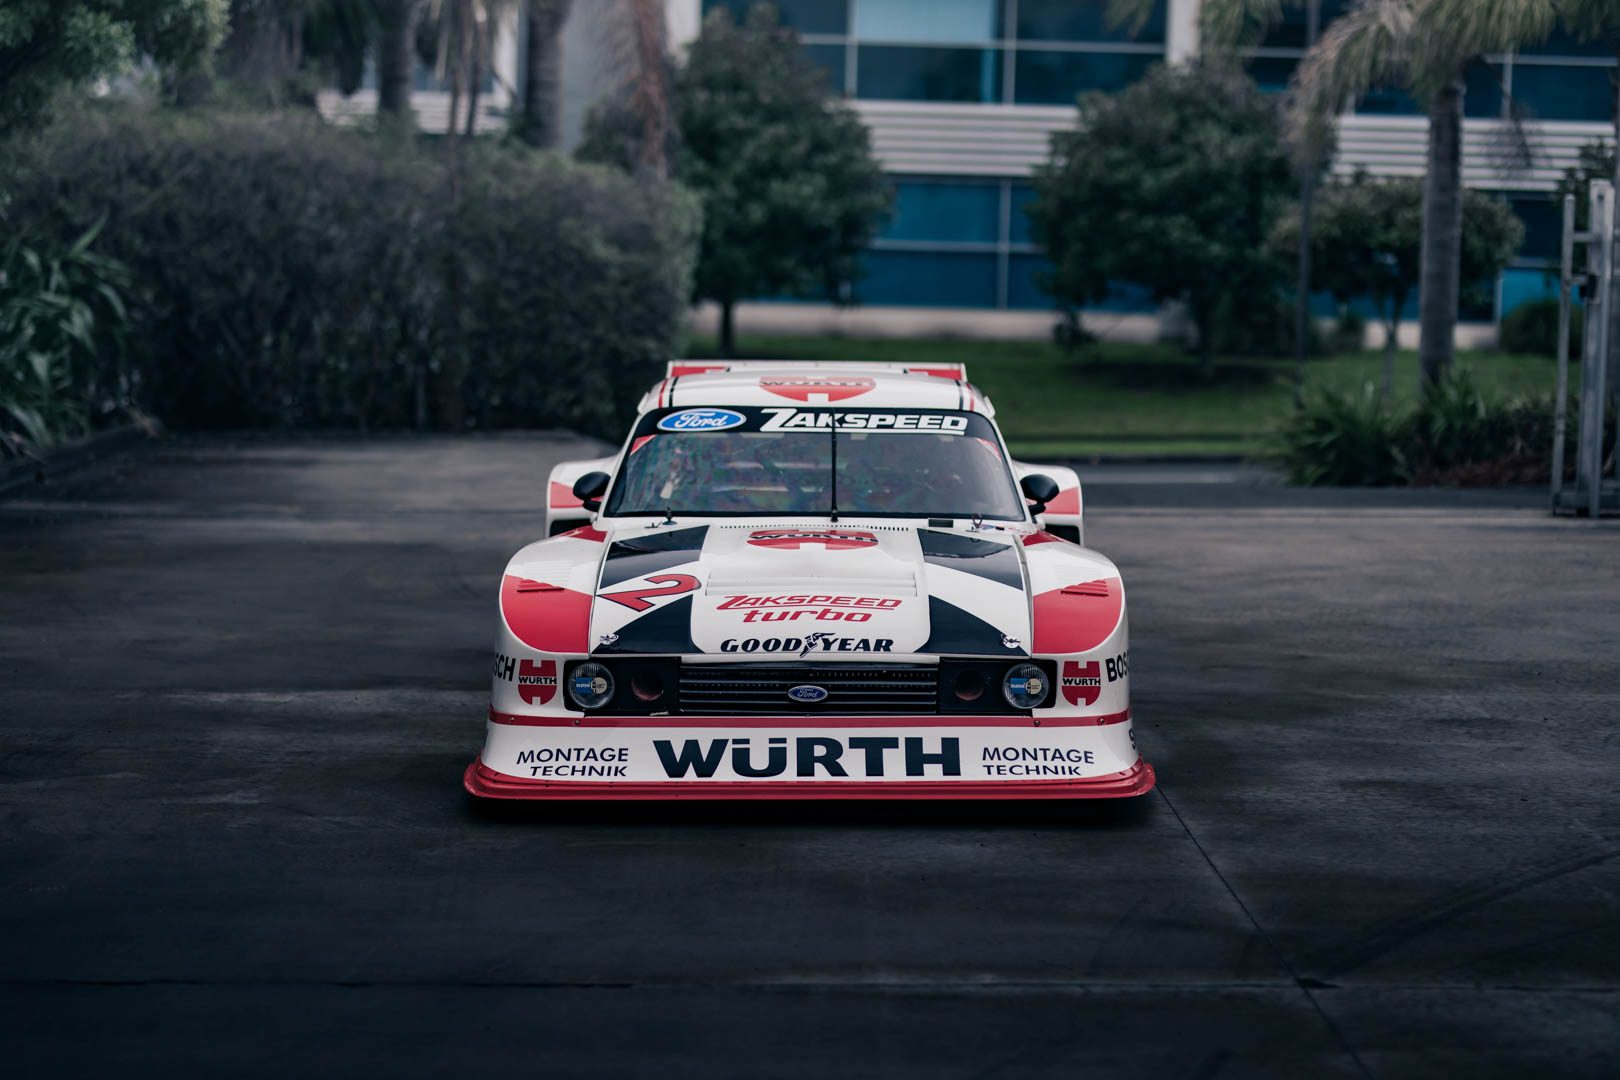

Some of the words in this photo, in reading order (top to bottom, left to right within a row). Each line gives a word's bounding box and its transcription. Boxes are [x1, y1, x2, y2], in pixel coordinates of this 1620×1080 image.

[674, 412, 728, 428] Ford
[595, 573, 702, 613] 2
[716, 595, 902, 610] ZAKSPEED
[743, 608, 873, 623] turbo
[720, 637, 802, 653] GOOD
[821, 637, 894, 653] YEAR
[516, 747, 629, 765] MONTAGE
[652, 737, 962, 779] WÜRTH
[981, 747, 1095, 765] MONTAGE
[530, 765, 628, 778] TECHNIK
[983, 764, 1083, 776] TECHNIK
